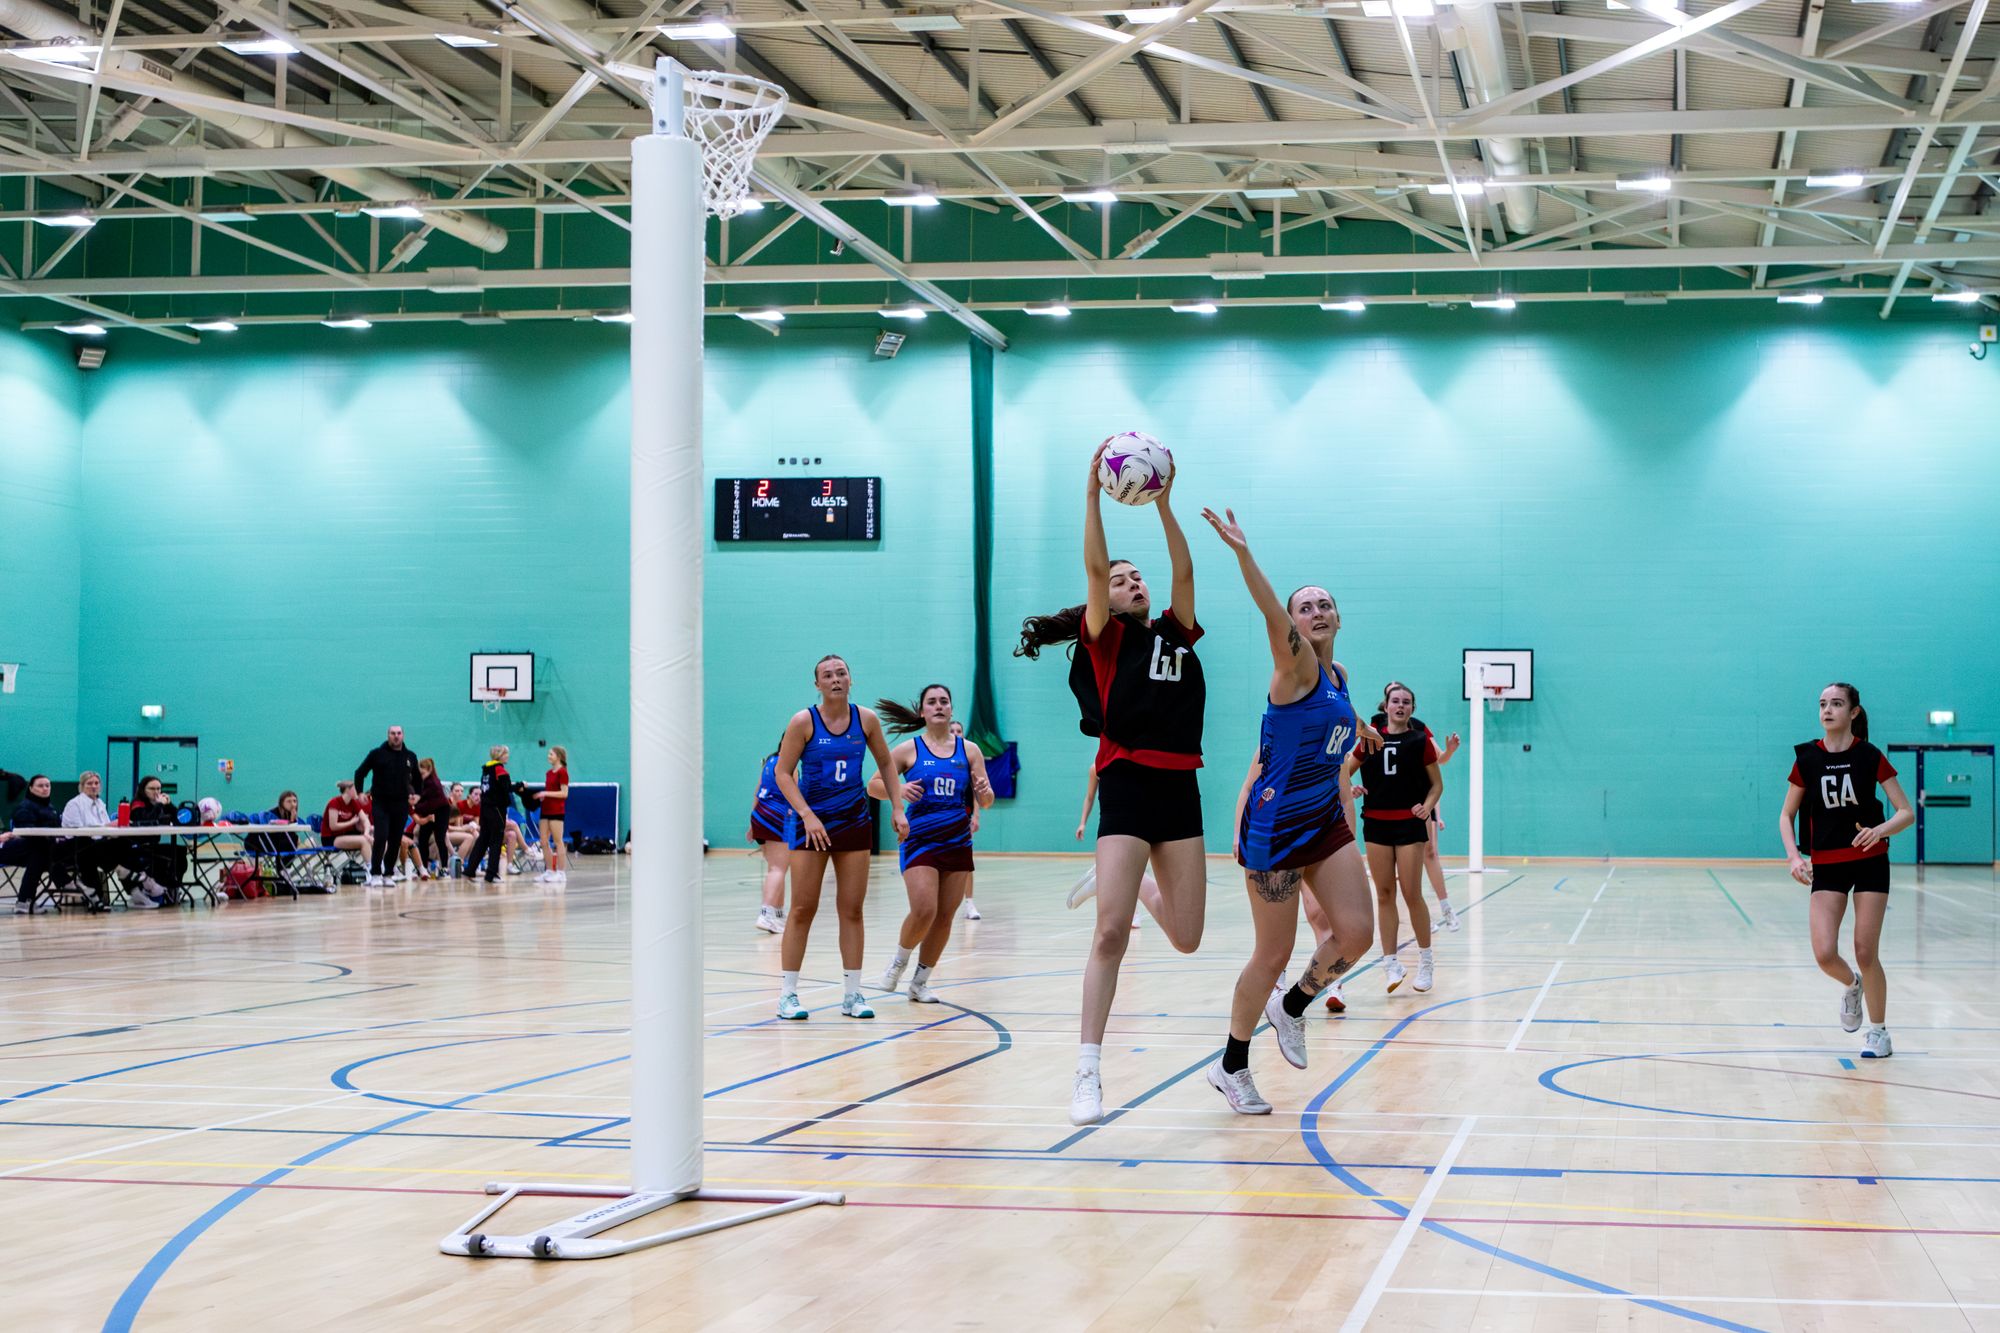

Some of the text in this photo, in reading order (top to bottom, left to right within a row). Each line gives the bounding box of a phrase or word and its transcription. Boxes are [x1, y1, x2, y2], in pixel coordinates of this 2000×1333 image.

[757, 480, 769, 497] 2
[822, 480, 832, 496] 3
[752, 497, 780, 508] HOME
[811, 496, 848, 507] GUESTS
[1325, 724, 1352, 755] GK
[834, 759, 847, 782] C
[1383, 746, 1397, 775] C
[933, 776, 956, 796] GD
[1820, 773, 1859, 810] GA
